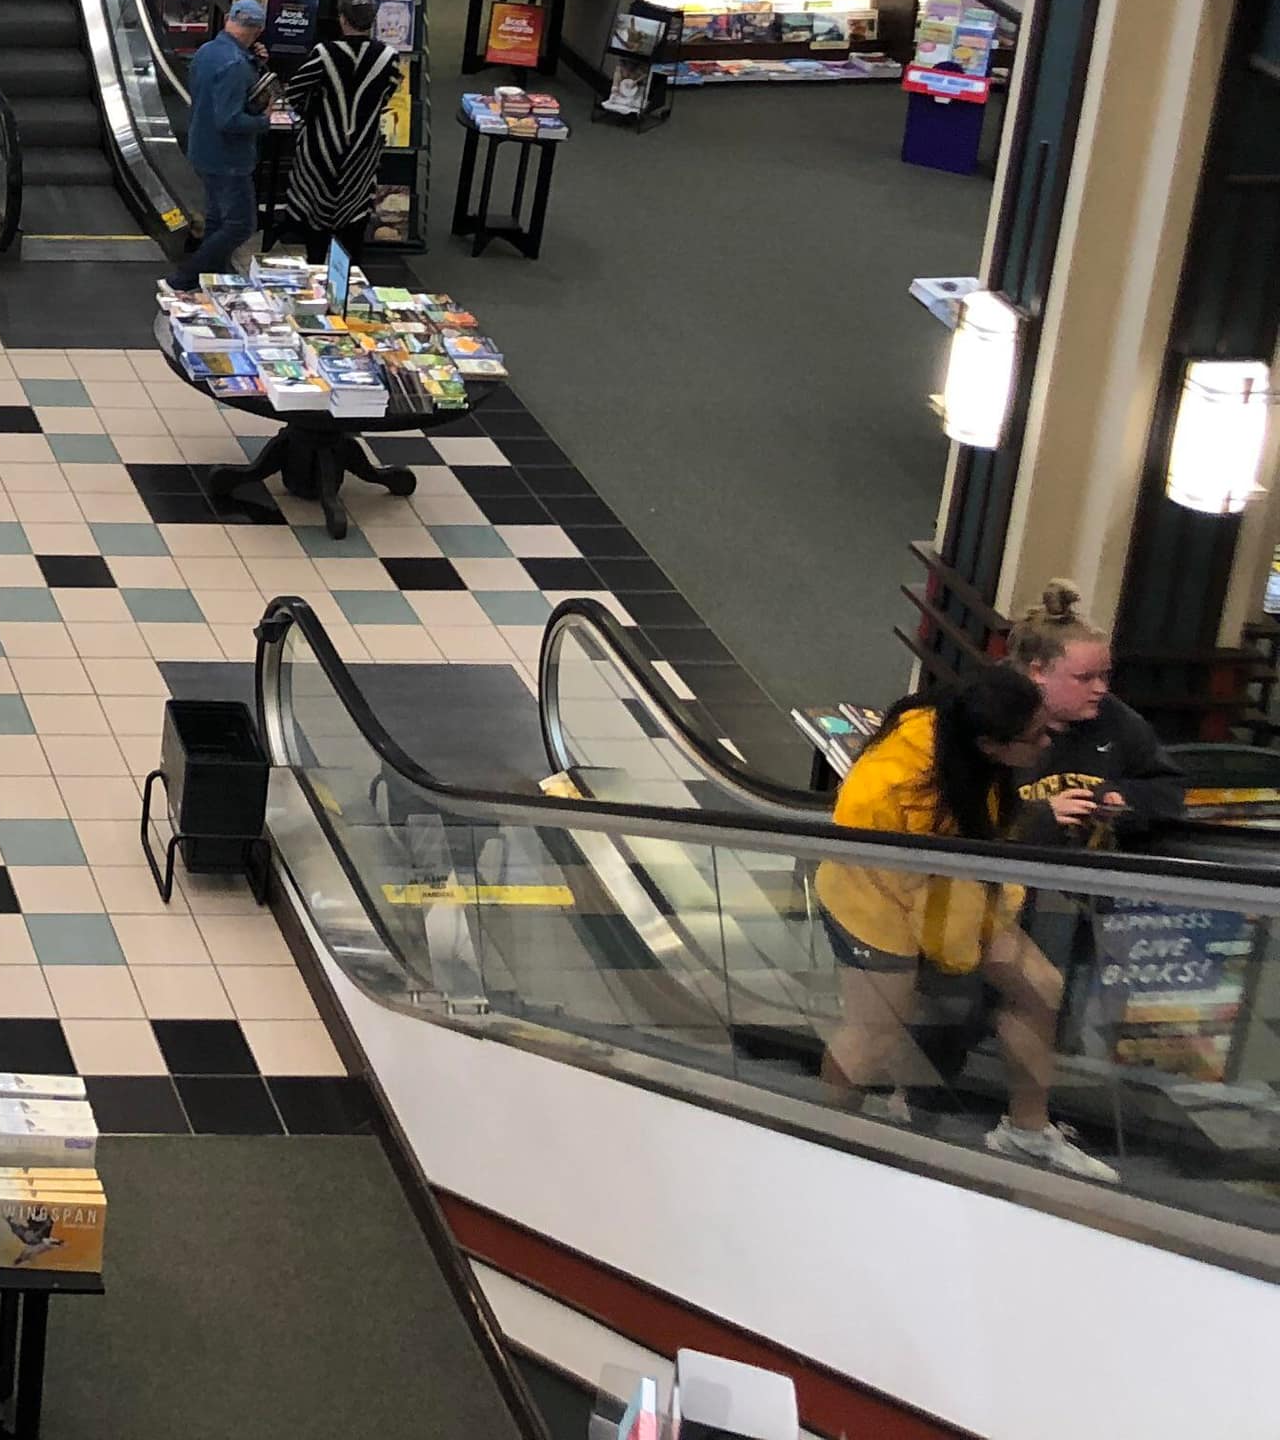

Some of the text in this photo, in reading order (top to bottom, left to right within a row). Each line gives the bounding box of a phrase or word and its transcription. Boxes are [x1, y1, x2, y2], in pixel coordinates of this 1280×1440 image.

[280, 10, 303, 20] Book
[274, 17, 309, 27] Awards
[504, 17, 527, 28] Book
[497, 24, 534, 35] Awards
[2, 1204, 99, 1225] WINGSPAN
